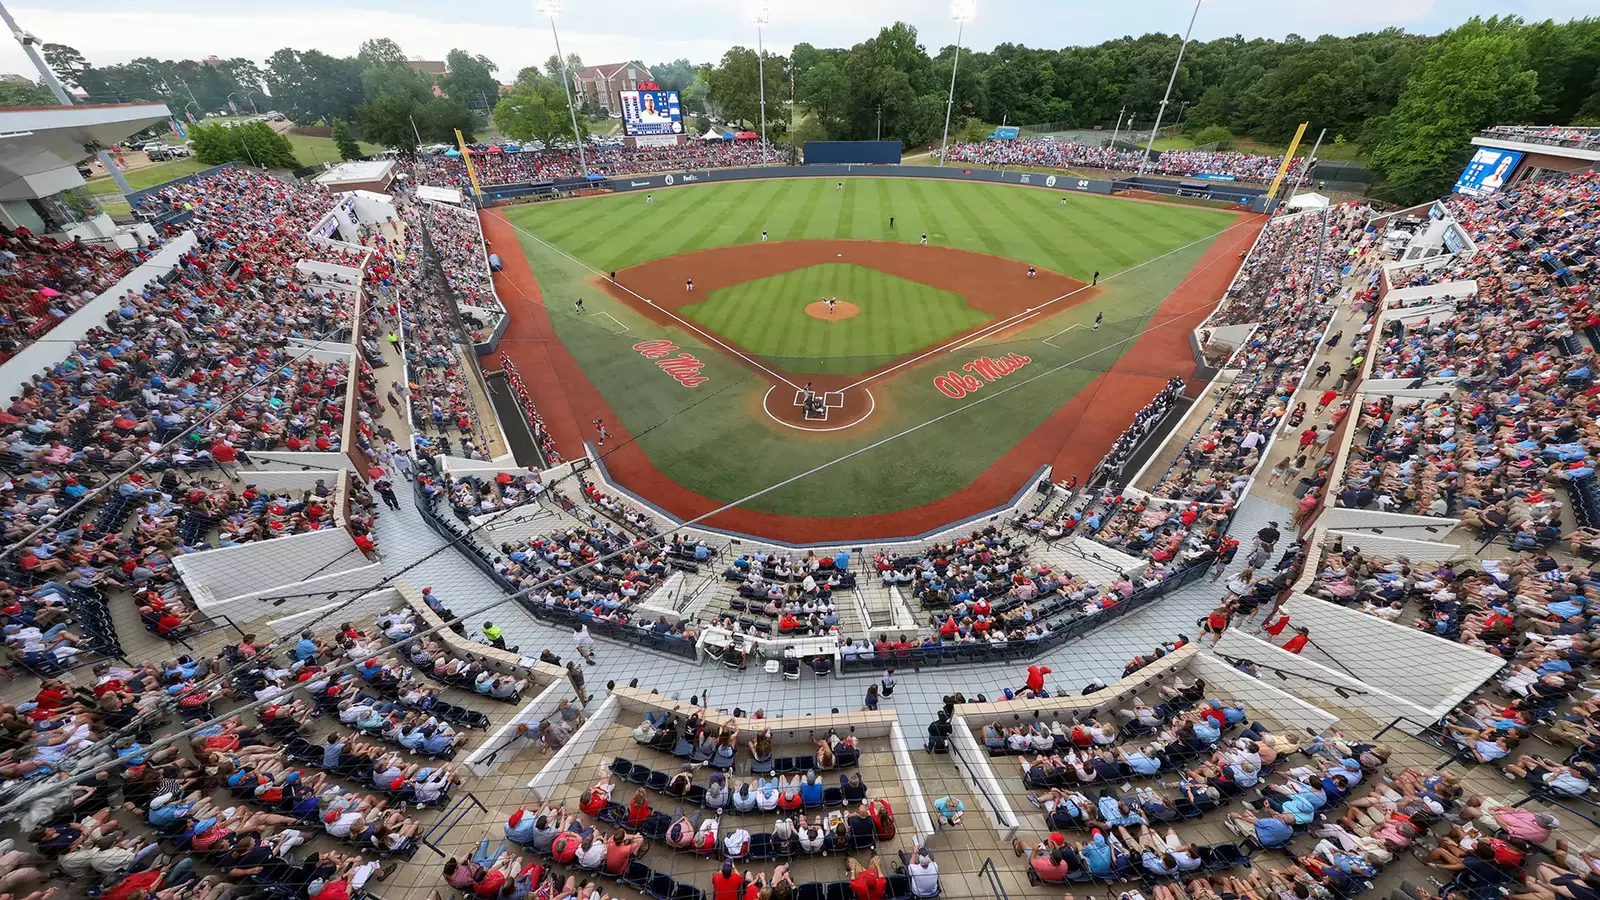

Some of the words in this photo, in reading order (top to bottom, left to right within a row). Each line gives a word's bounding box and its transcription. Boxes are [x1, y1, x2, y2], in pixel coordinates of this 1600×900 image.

[632, 339, 680, 359] Ole
[655, 352, 709, 388] Miss
[933, 370, 984, 399] Ole
[962, 352, 1032, 381] Miss
